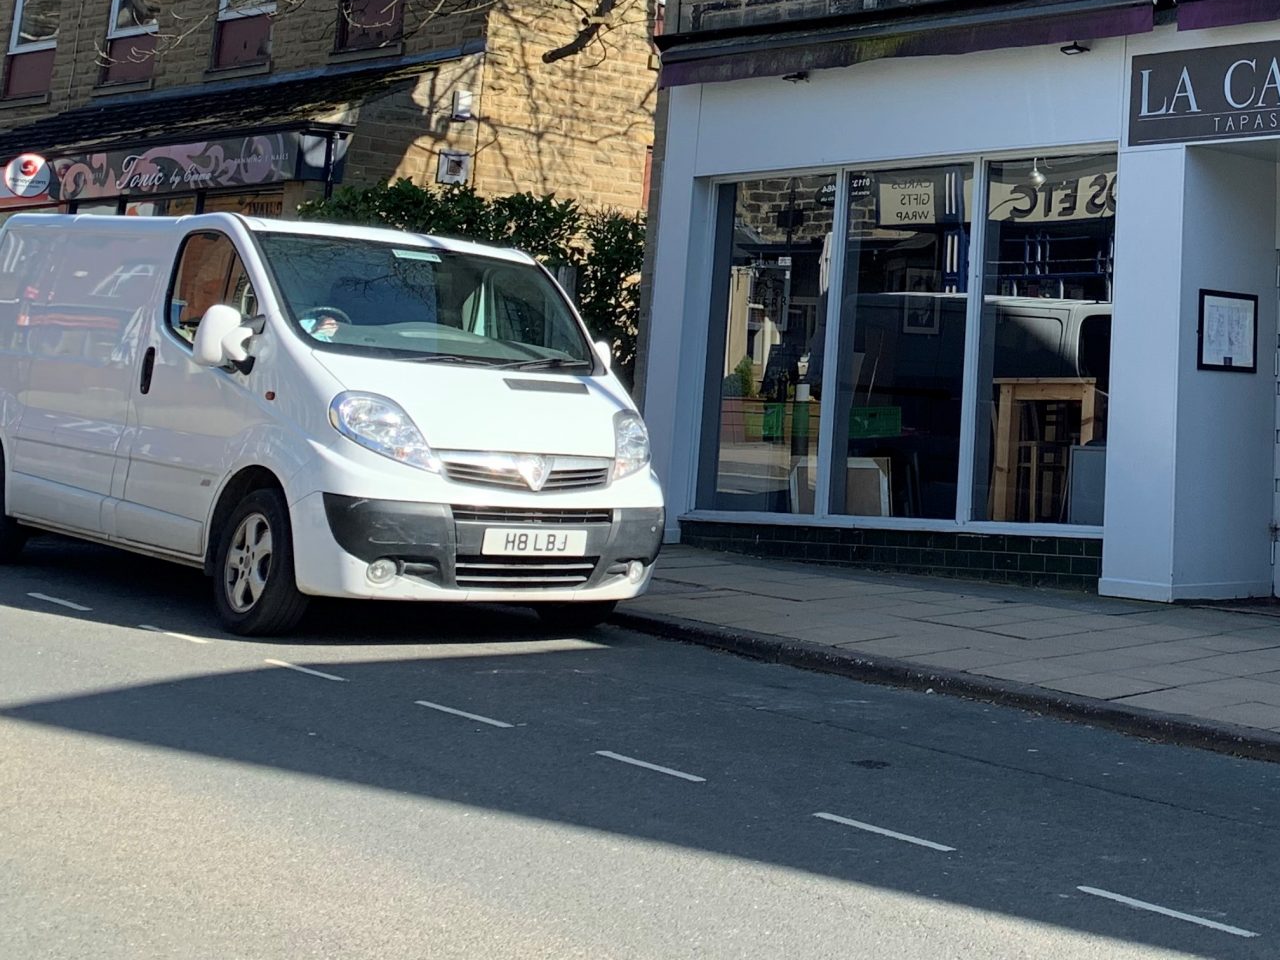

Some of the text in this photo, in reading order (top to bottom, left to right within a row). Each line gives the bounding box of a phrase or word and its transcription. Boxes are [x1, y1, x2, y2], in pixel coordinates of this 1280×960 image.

[1139, 66, 1202, 117] LA
[1213, 112, 1278, 132] TAPAS
[116, 154, 164, 189] Tonic
[169, 168, 181, 189] by
[504, 532, 568, 552] H8 LBJ
